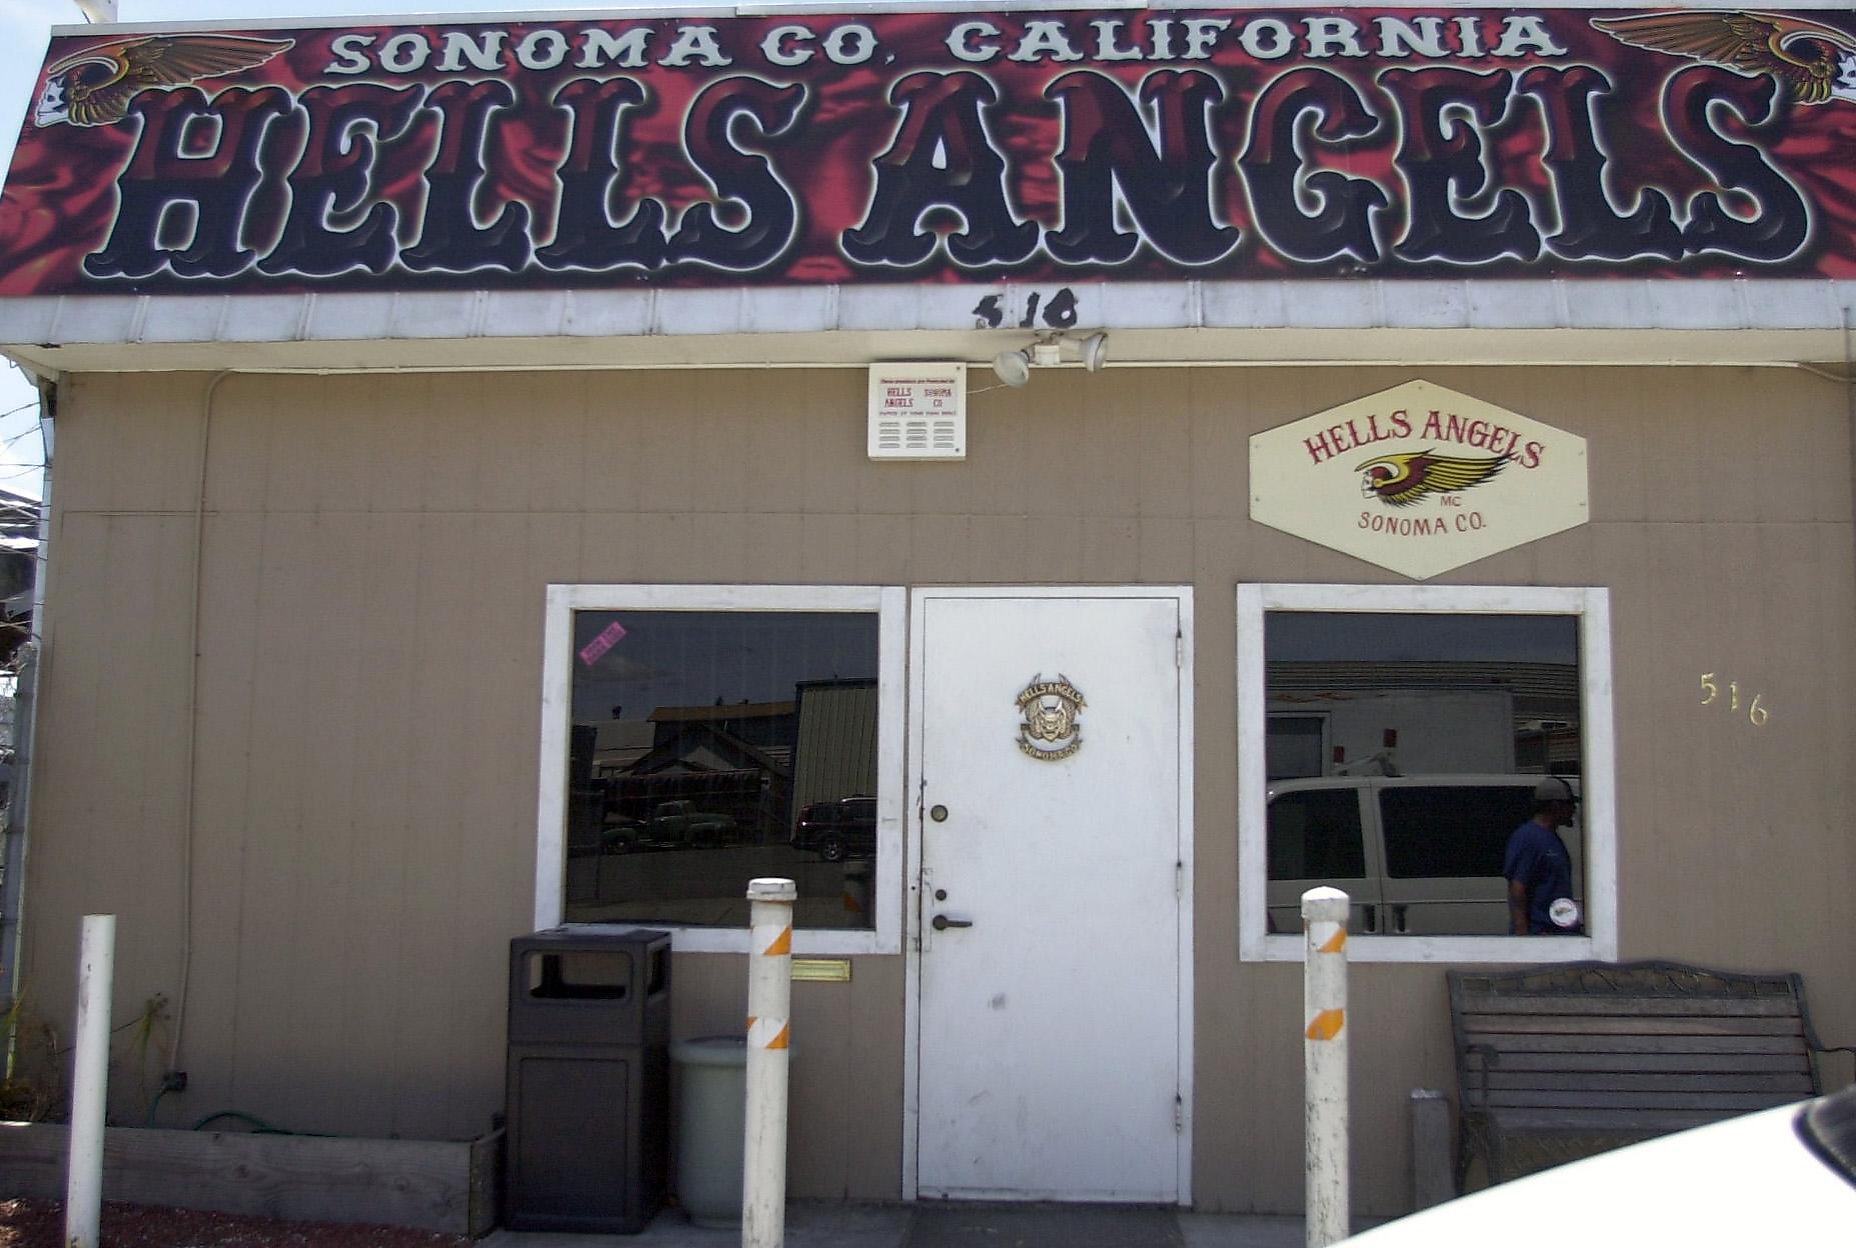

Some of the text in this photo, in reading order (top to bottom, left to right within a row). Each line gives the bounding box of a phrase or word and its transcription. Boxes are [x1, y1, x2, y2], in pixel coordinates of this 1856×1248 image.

[323, 24, 733, 76] SONOMA
[944, 15, 1569, 62] CALIFORNIA
[80, 63, 1817, 280] HELLS ANGELS
[1302, 409, 1546, 470] HELLS ANGELS
[1357, 511, 1488, 536] SONOMA CO.
[1439, 495, 1461, 508] MC
[1047, 683, 1081, 702] ANGELS
[1700, 672, 1769, 726] 516
